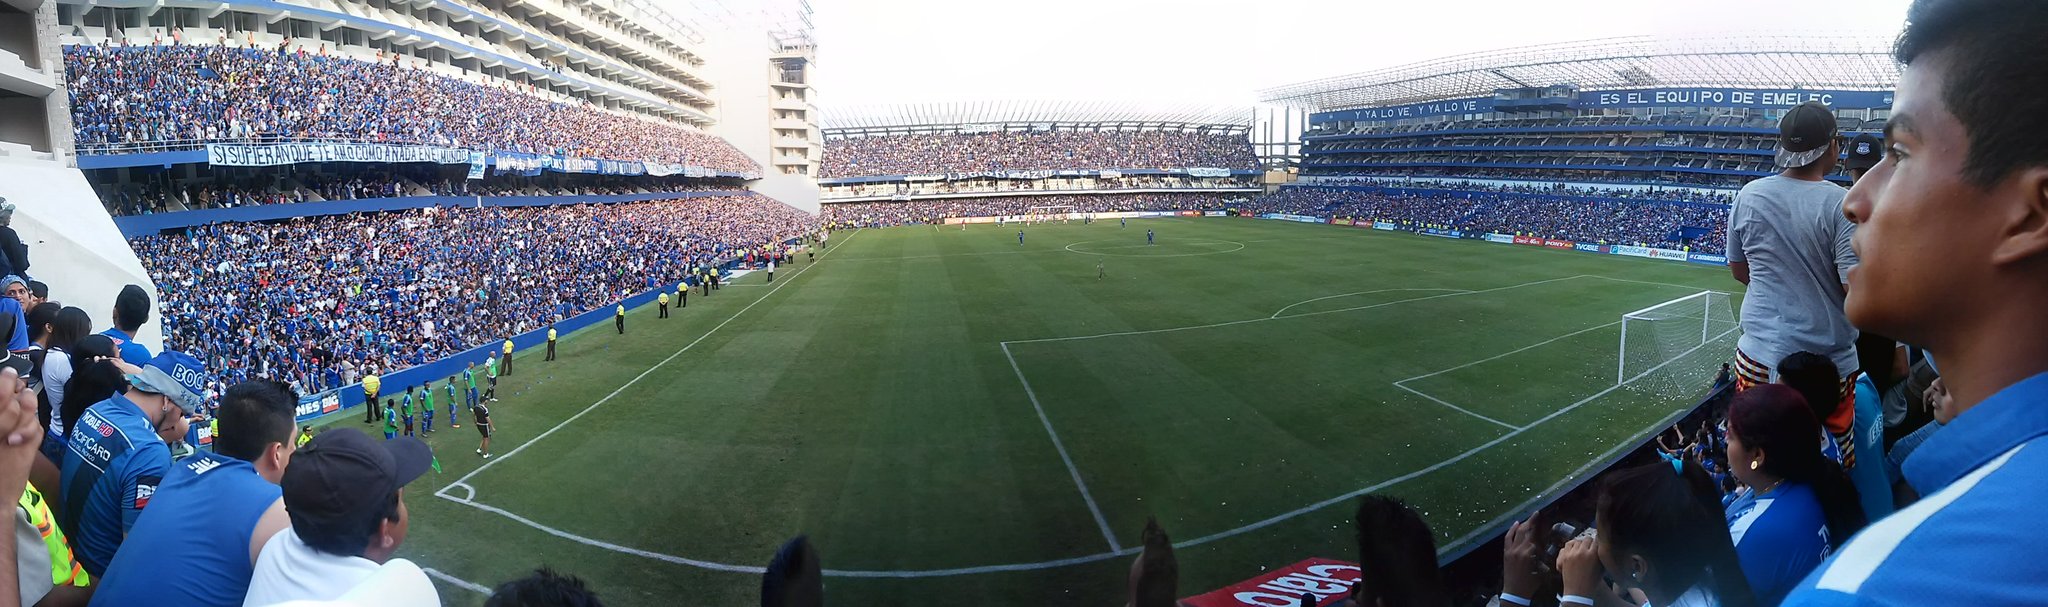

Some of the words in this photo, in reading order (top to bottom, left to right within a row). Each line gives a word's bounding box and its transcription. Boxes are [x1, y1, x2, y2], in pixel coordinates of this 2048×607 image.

[1600, 93, 1620, 105] ES
[1627, 92, 1648, 104] EL
[1655, 91, 1724, 103] EQUIPO
[1731, 91, 1755, 104] DE
[1354, 111, 1361, 119] Y
[1365, 110, 1377, 118] YA
[1381, 109, 1394, 118] LO
[1418, 106, 1424, 115] Y
[1428, 104, 1440, 113] YA
[1444, 102, 1458, 112] LO
[315, 144, 333, 161] TE
